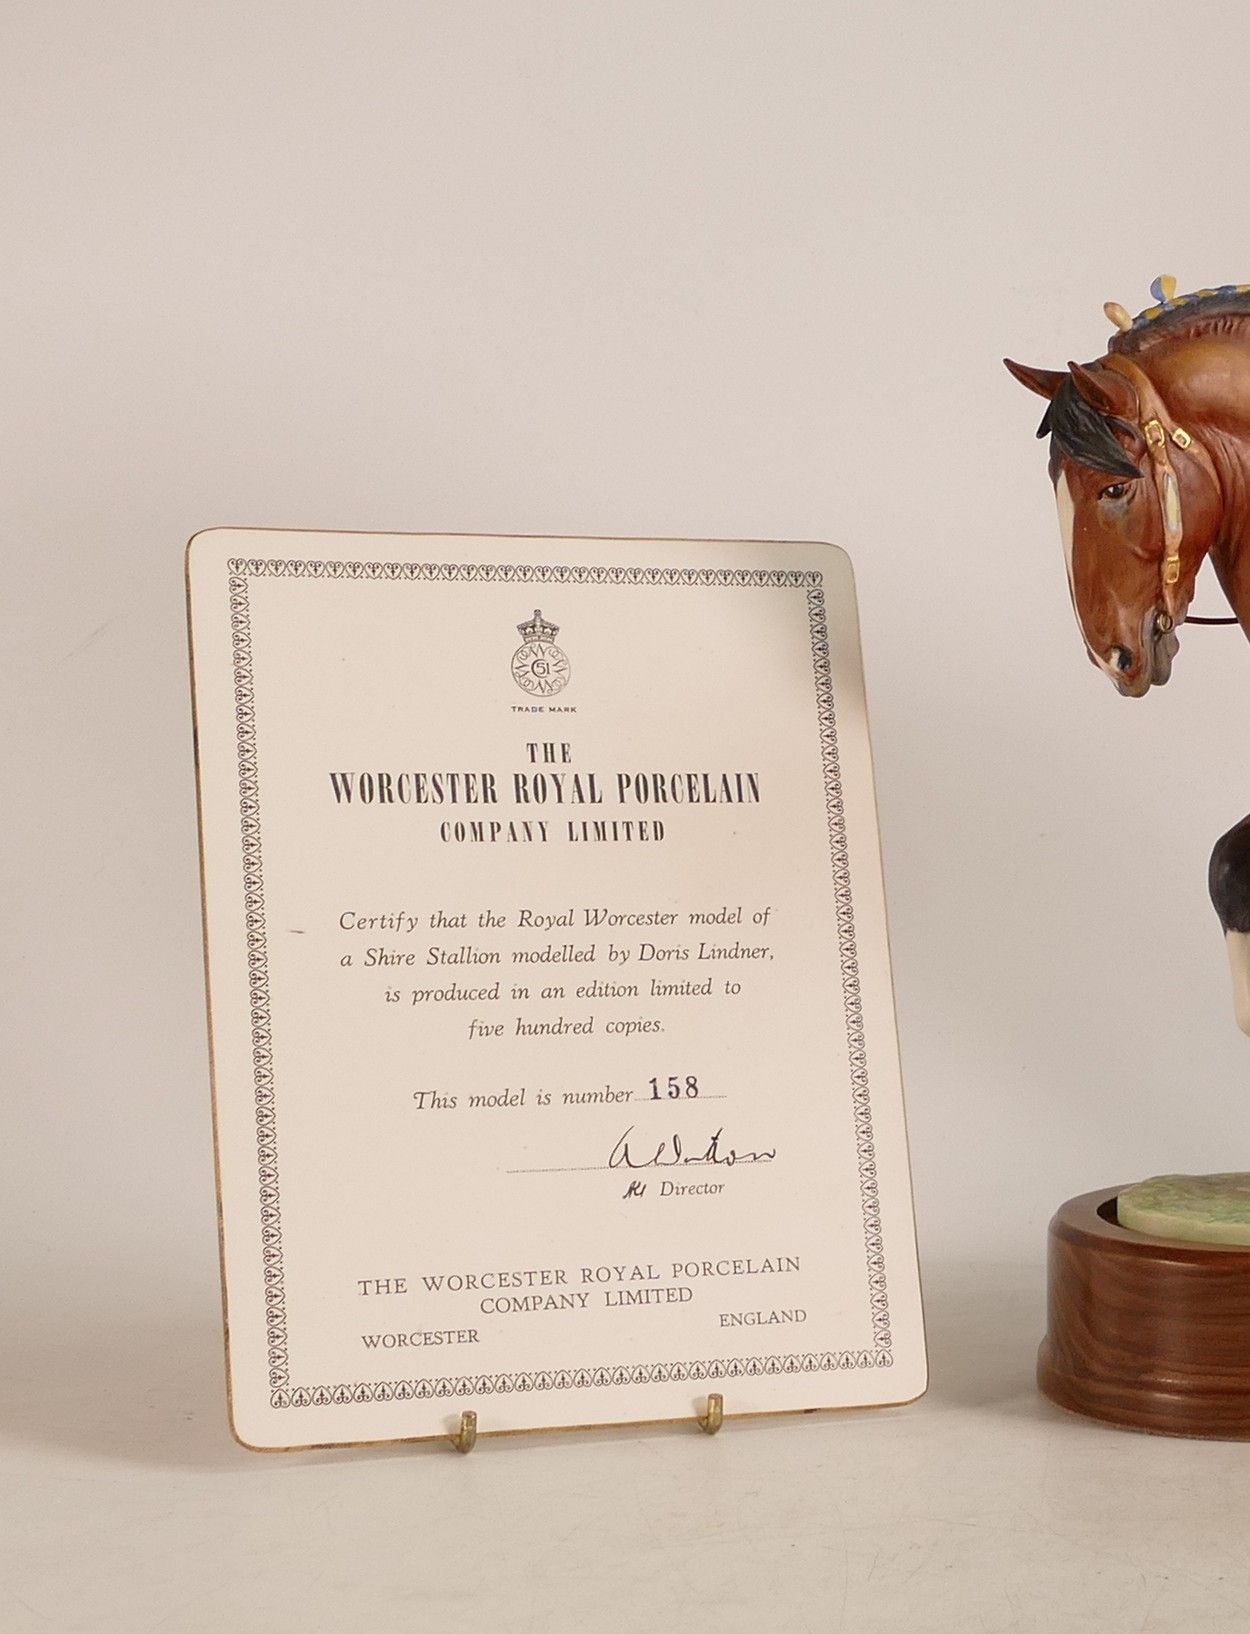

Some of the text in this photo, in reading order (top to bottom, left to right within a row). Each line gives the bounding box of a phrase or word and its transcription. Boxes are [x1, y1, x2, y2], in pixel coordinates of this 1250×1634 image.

[510, 705, 577, 714] TRADE MARK
[525, 742, 572, 764] THE
[328, 771, 760, 805] WORCESTER ROYAL PORCELAIN
[439, 820, 665, 843] COMPANY LIMITED
[339, 906, 772, 934] Certify that the Royal Worcester model of
[339, 941, 774, 968] a Shire Stallion modelled by Doris Lindner,
[384, 976, 742, 1007] is produced in an edition limited to
[468, 1015, 665, 1041] five hundred copies.
[412, 1075, 701, 1110] This model is number 158
[659, 1180, 726, 1197] Director
[357, 1256, 800, 1296] THE WORCESTER ROYAL PORCELAIN
[479, 1286, 693, 1315] COMPANY LIMITED
[718, 1309, 807, 1328] ENGLAND
[360, 1328, 481, 1350] WORCESTER
